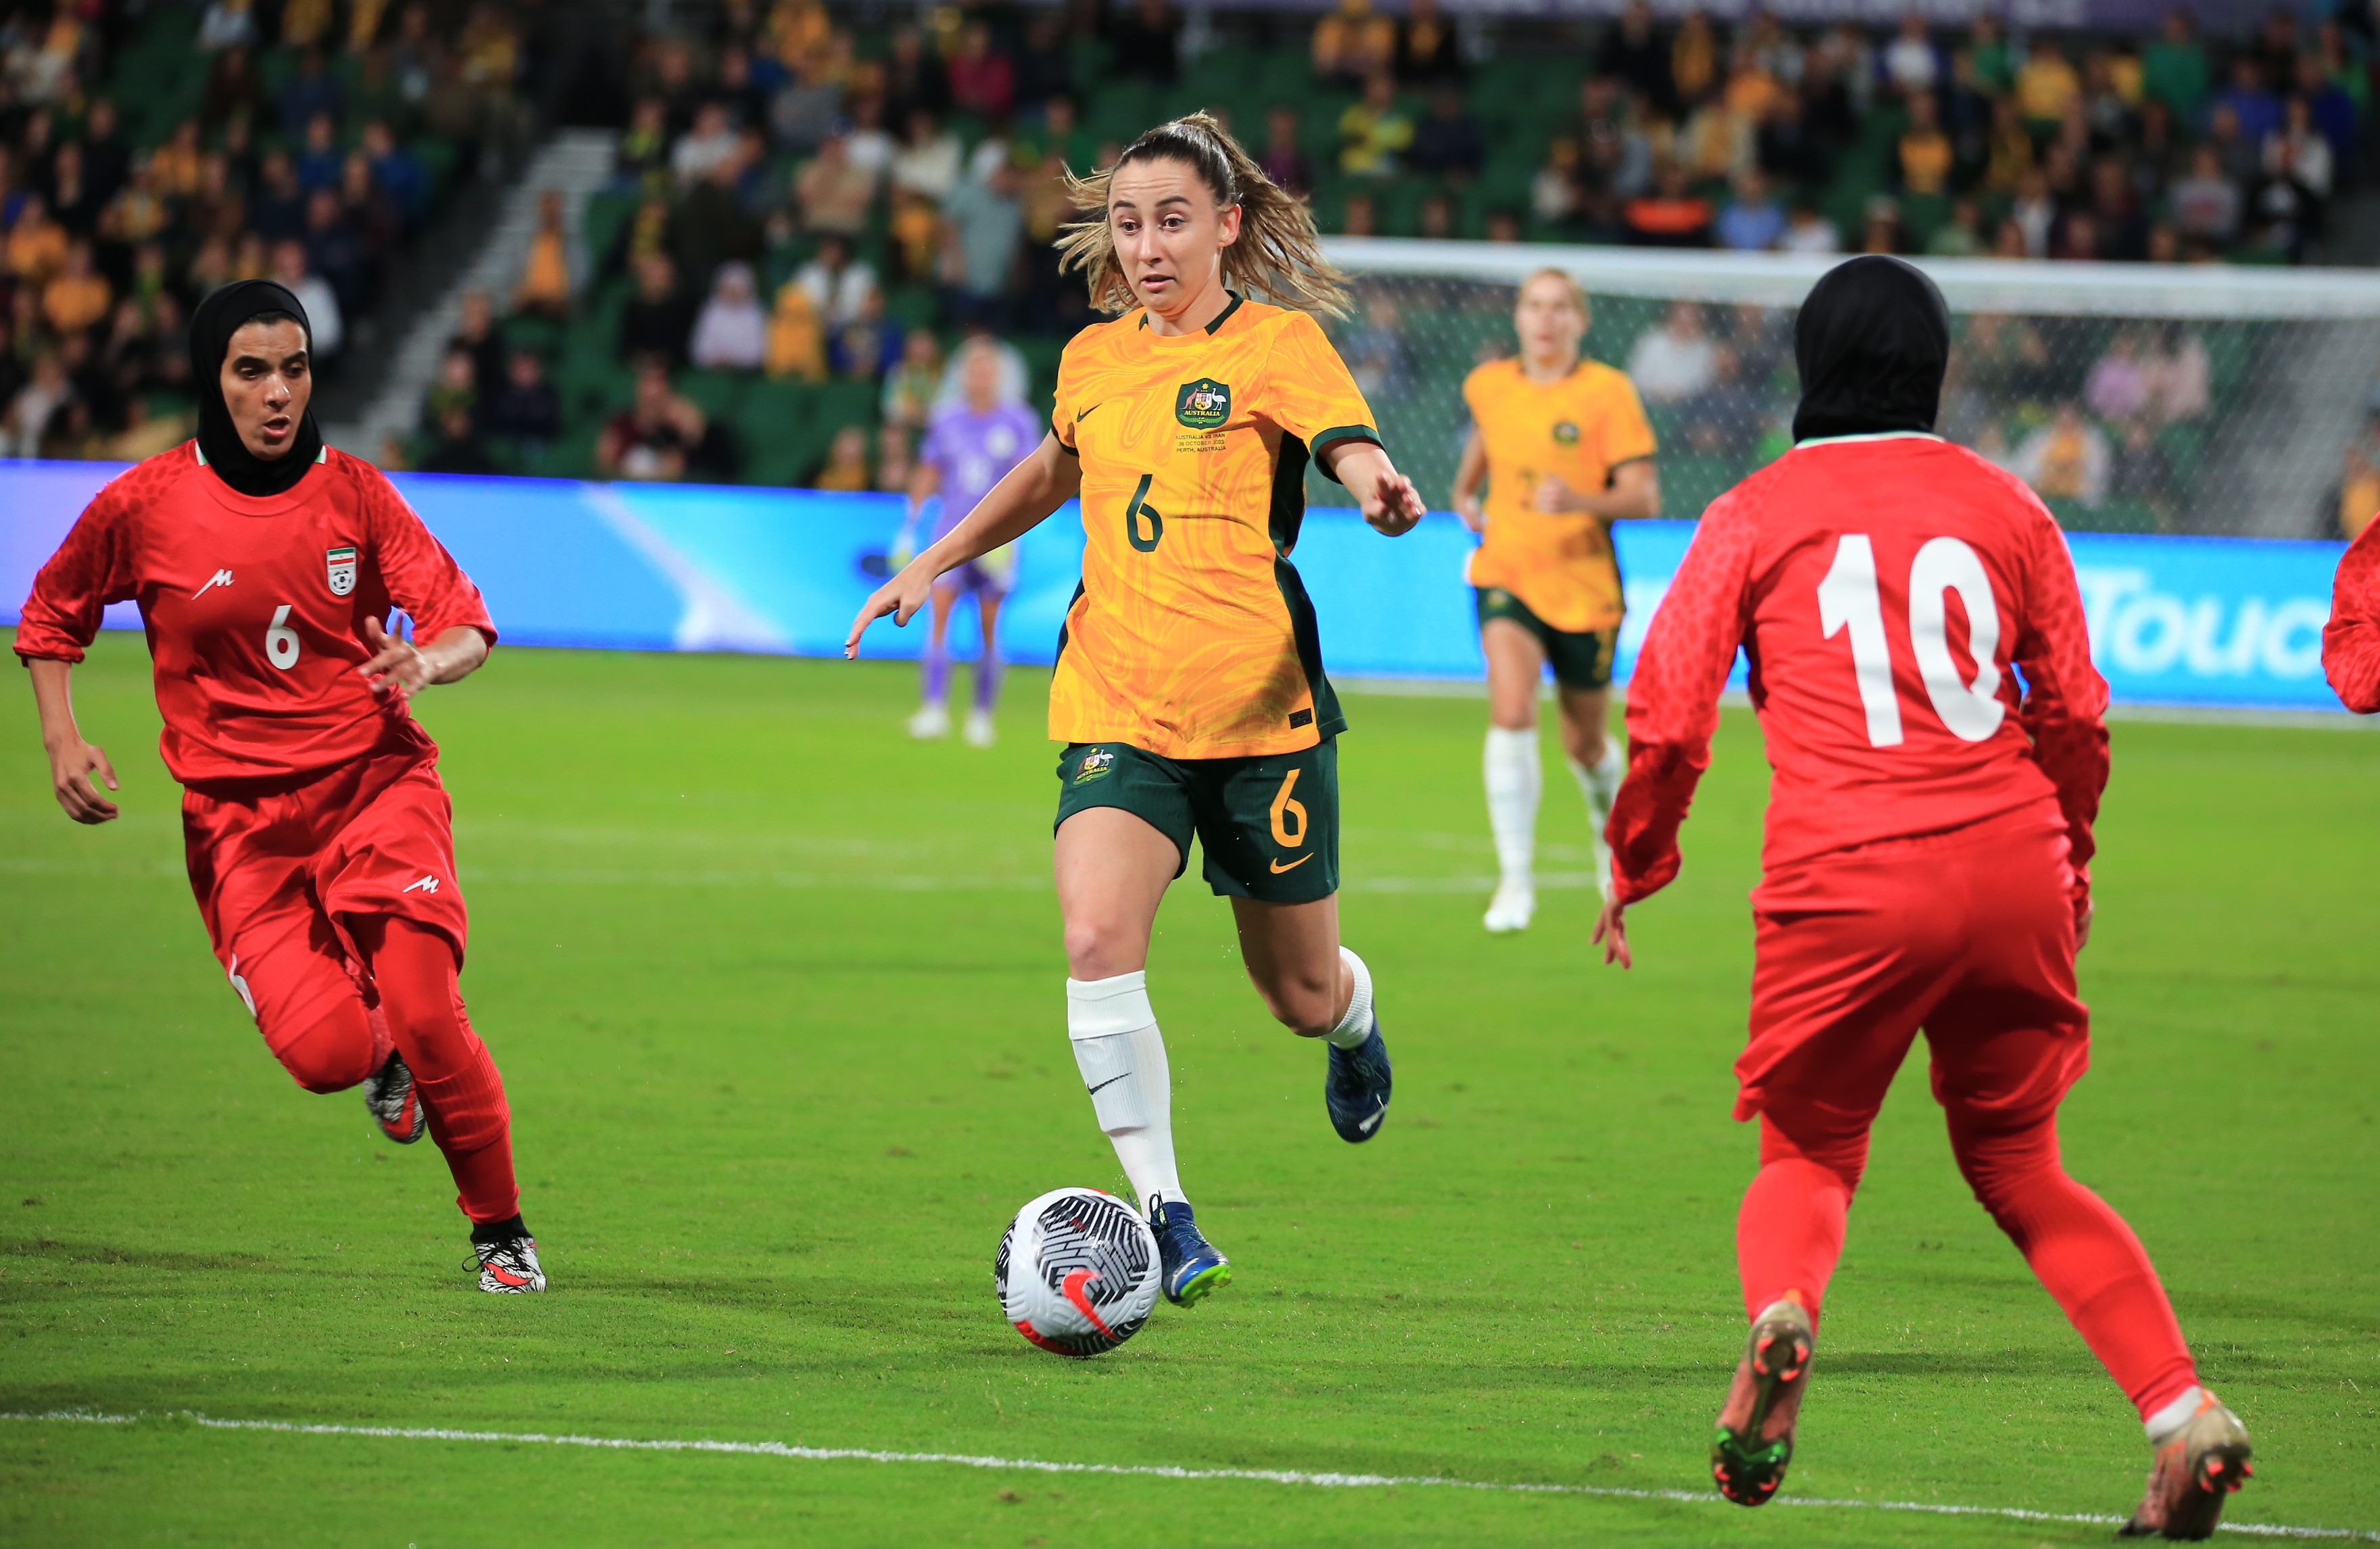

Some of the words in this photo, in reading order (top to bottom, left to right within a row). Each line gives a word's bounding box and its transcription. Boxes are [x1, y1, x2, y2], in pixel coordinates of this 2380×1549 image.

[1127, 474, 1163, 552] 6
[265, 604, 300, 670] 6
[1817, 533, 2006, 748] 10
[1269, 768, 1308, 848] 6
